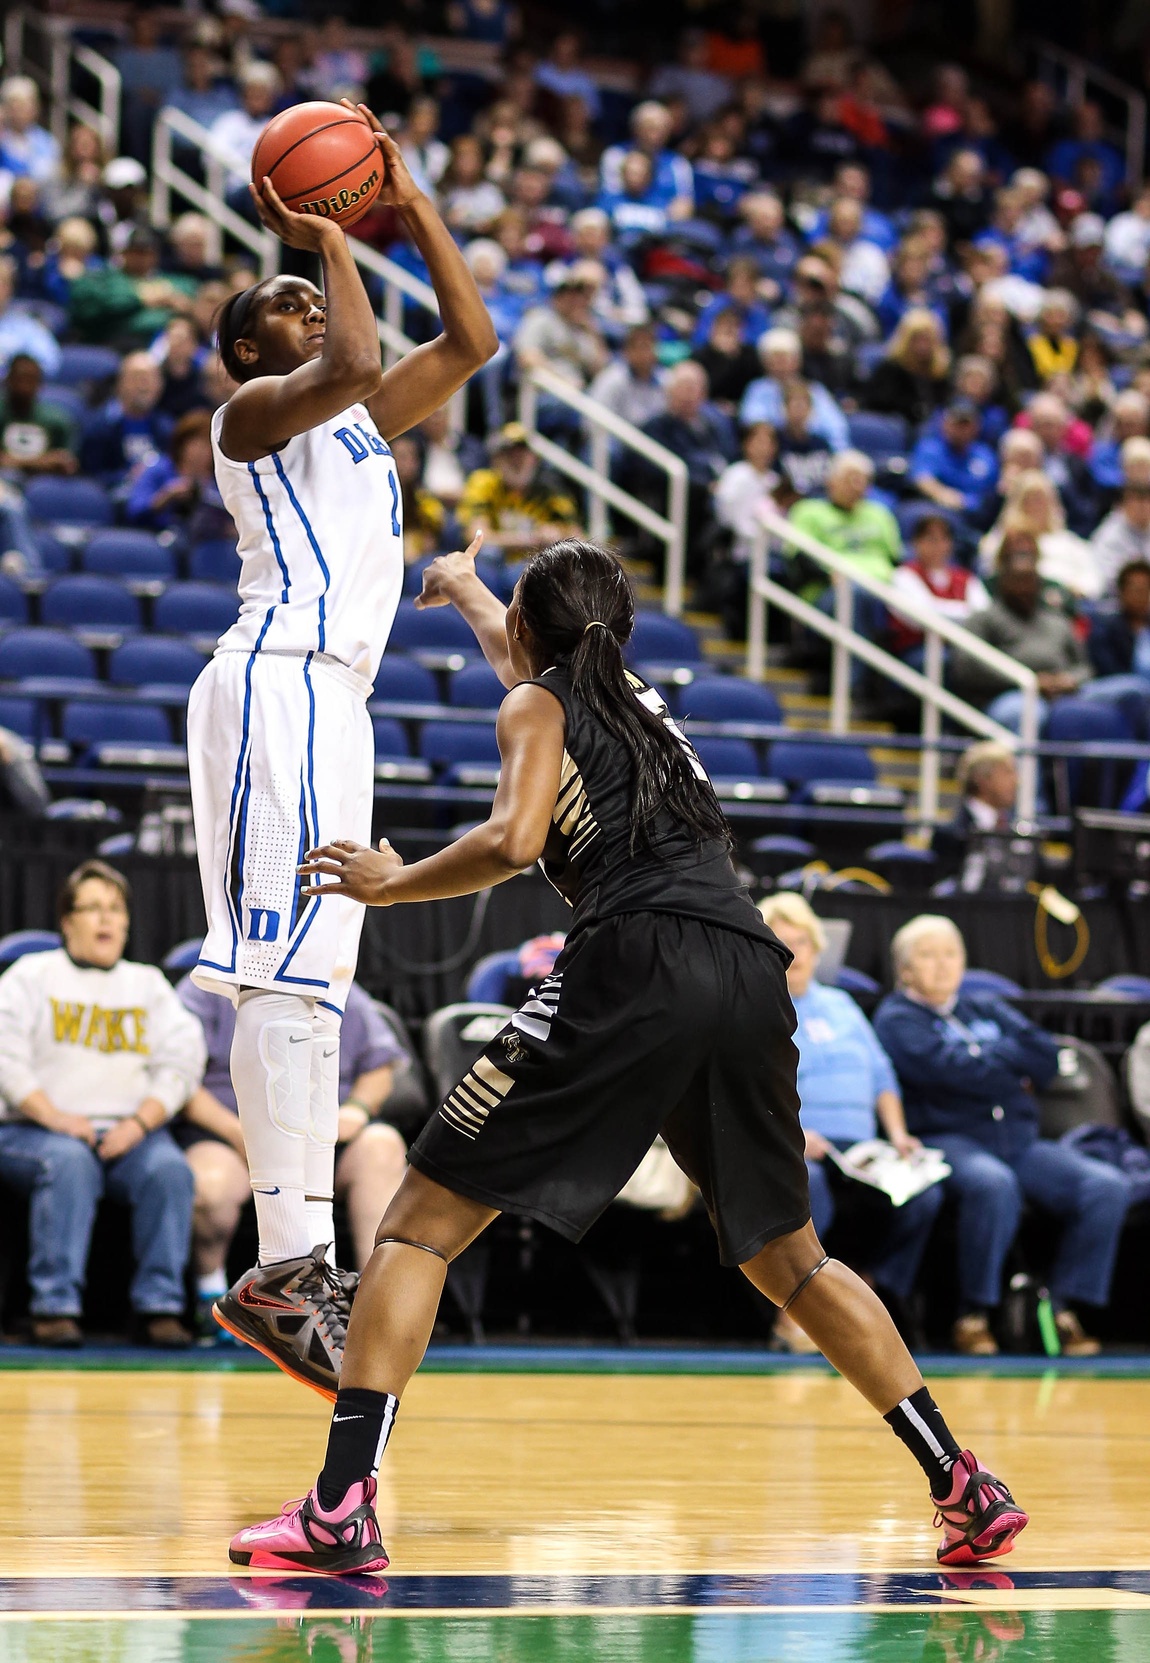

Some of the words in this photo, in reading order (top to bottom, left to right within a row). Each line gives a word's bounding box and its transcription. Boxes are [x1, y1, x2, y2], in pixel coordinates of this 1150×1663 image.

[300, 170, 379, 217] Wilson
[388, 470, 401, 537] 1
[247, 908, 280, 942] D
[50, 997, 149, 1055] WAKE
